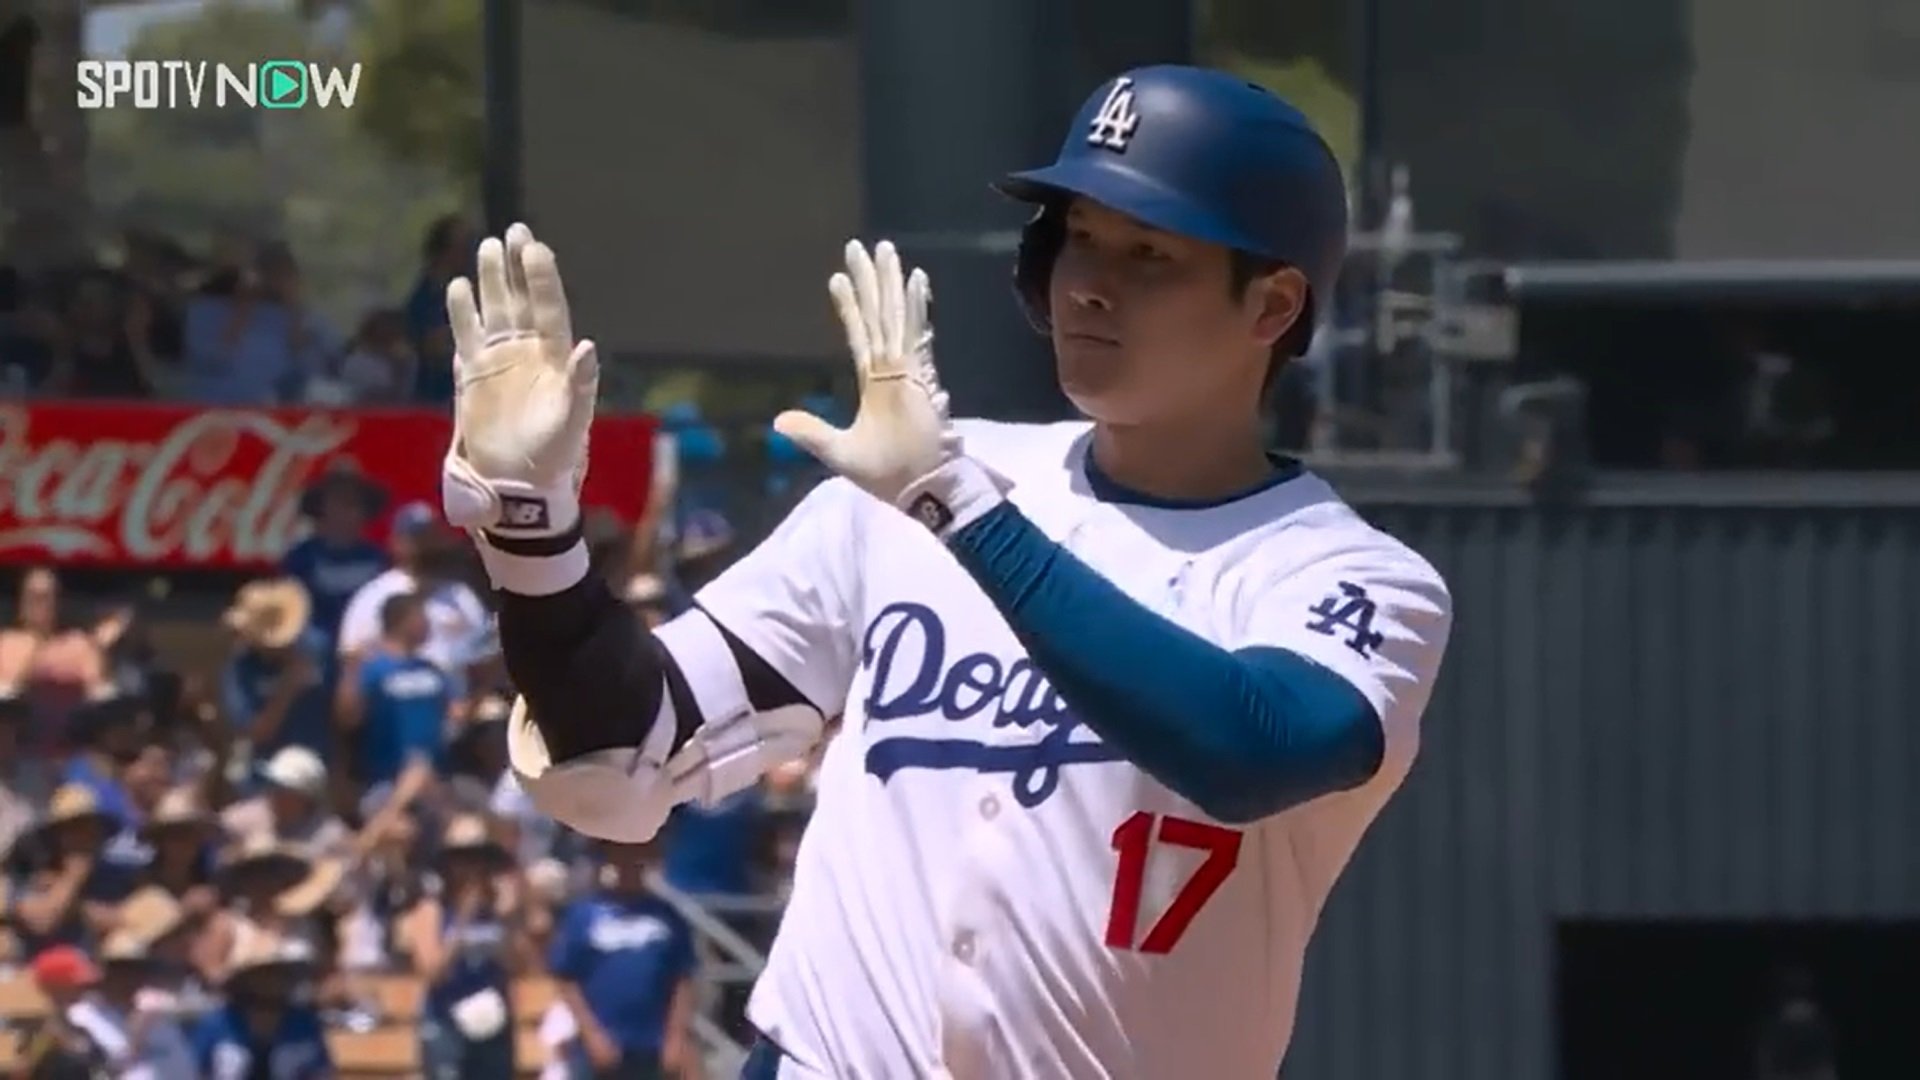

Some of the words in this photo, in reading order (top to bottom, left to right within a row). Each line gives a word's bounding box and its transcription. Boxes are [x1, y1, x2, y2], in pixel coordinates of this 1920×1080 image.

[1087, 76, 1137, 149] LA
[1305, 580, 1384, 660] LA
[863, 602, 1092, 808] Dodg
[1104, 810, 1244, 954] 17
